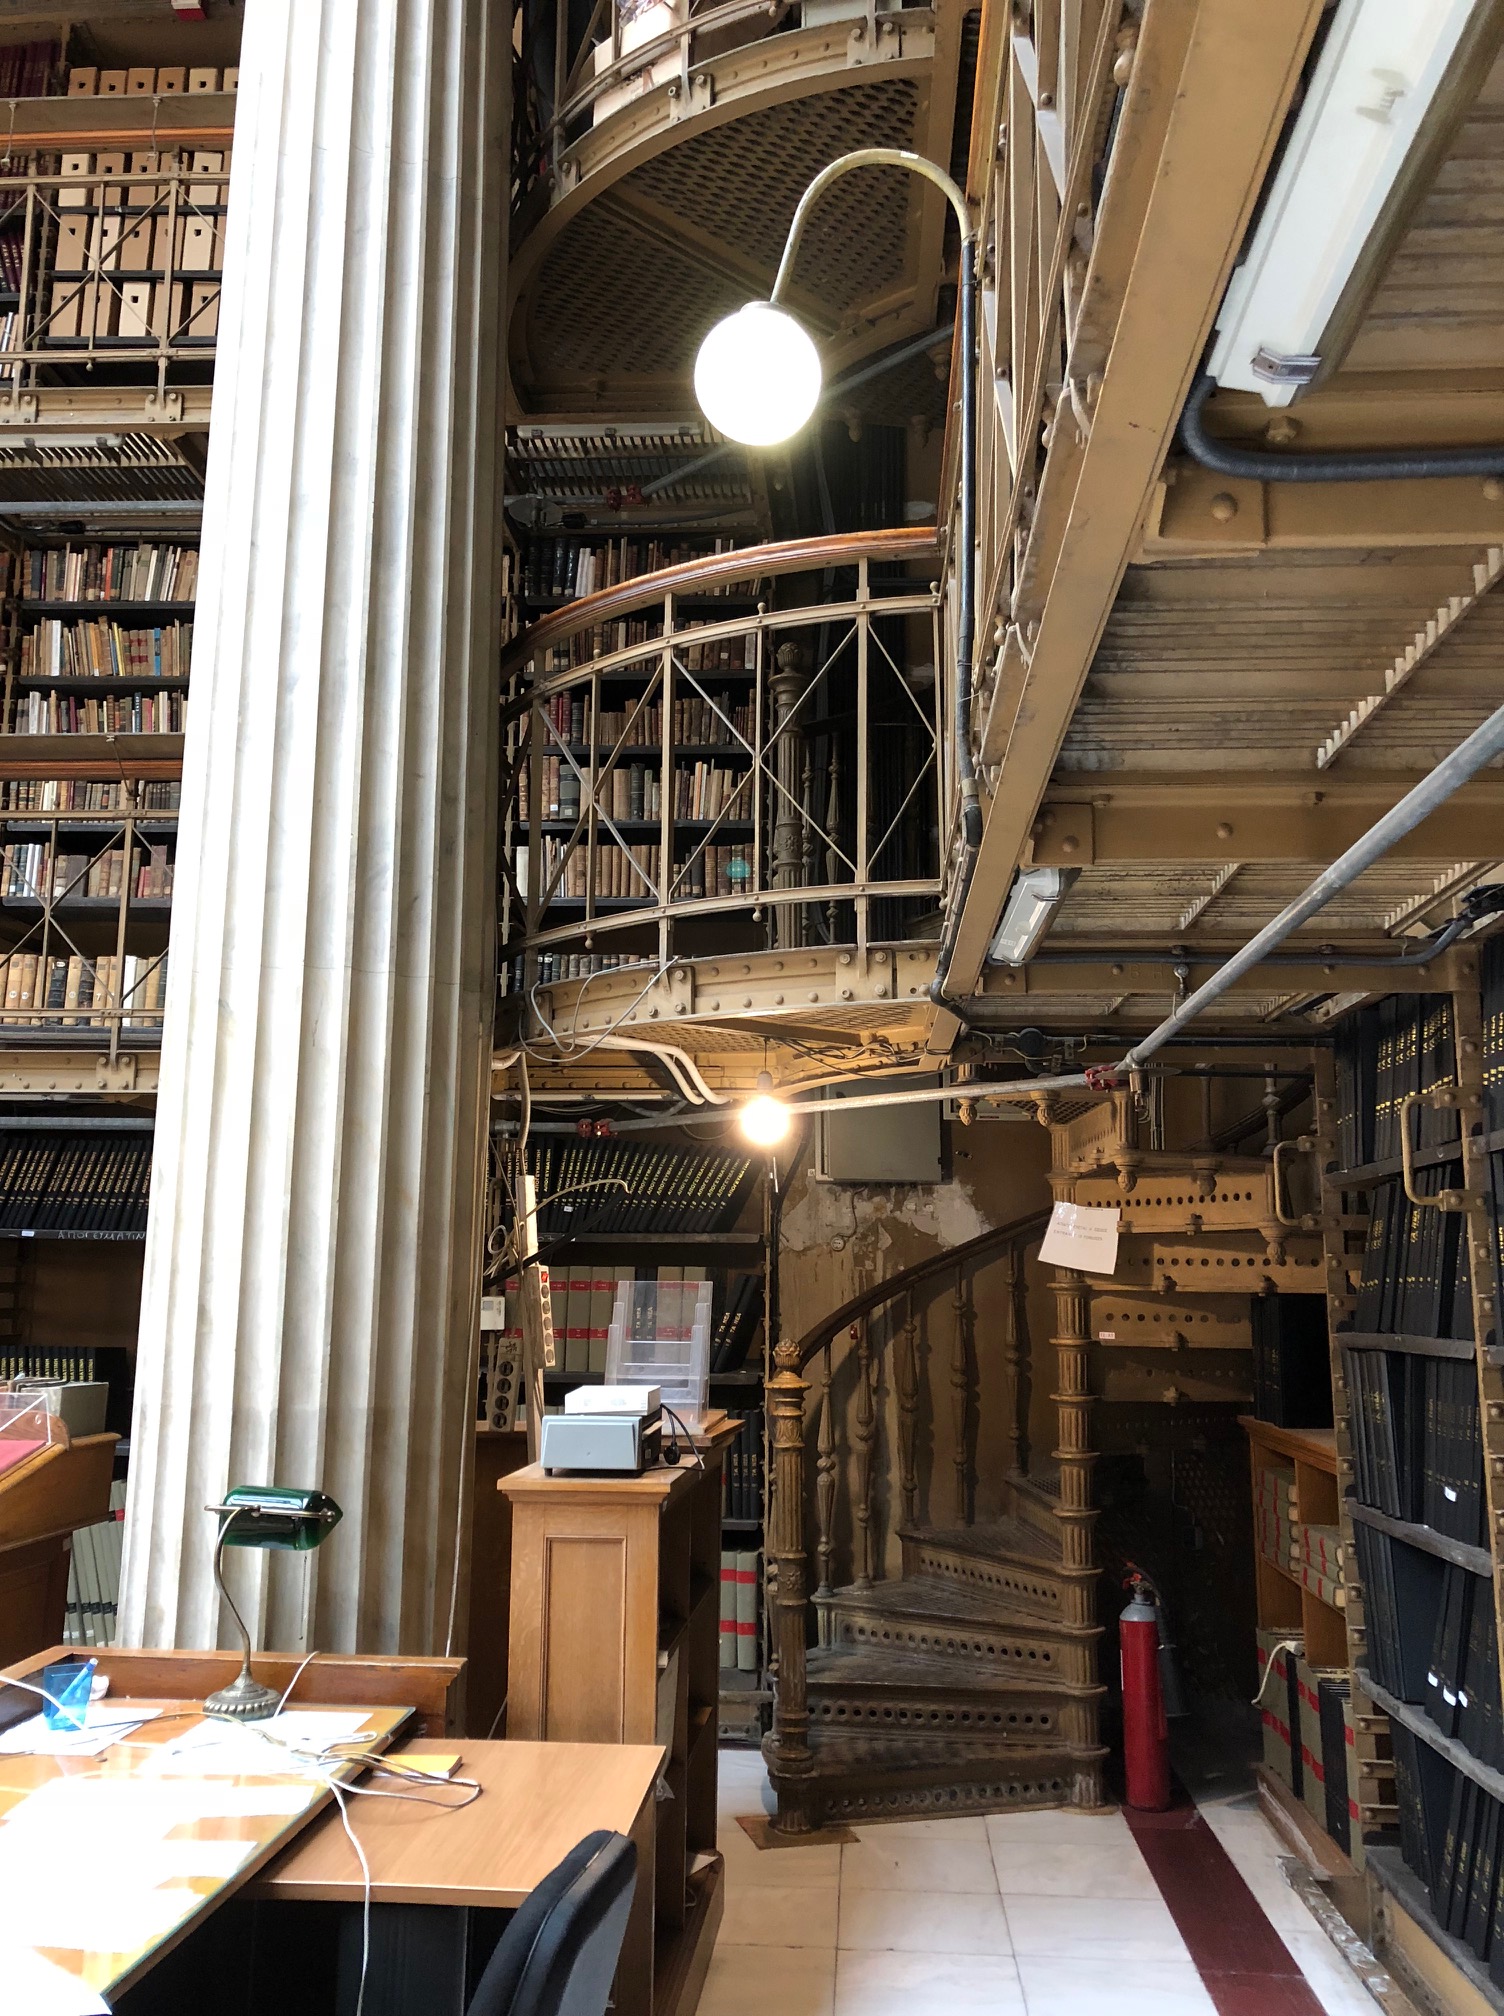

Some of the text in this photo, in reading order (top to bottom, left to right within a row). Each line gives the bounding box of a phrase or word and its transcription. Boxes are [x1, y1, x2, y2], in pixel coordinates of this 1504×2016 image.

[58, 1230, 146, 1240] ΑΠΟΓΕΥΜΑΤΙΝ
[722, 1312, 731, 1324] ΝΕΑ
[734, 1312, 742, 1325] ΝΕΑ
